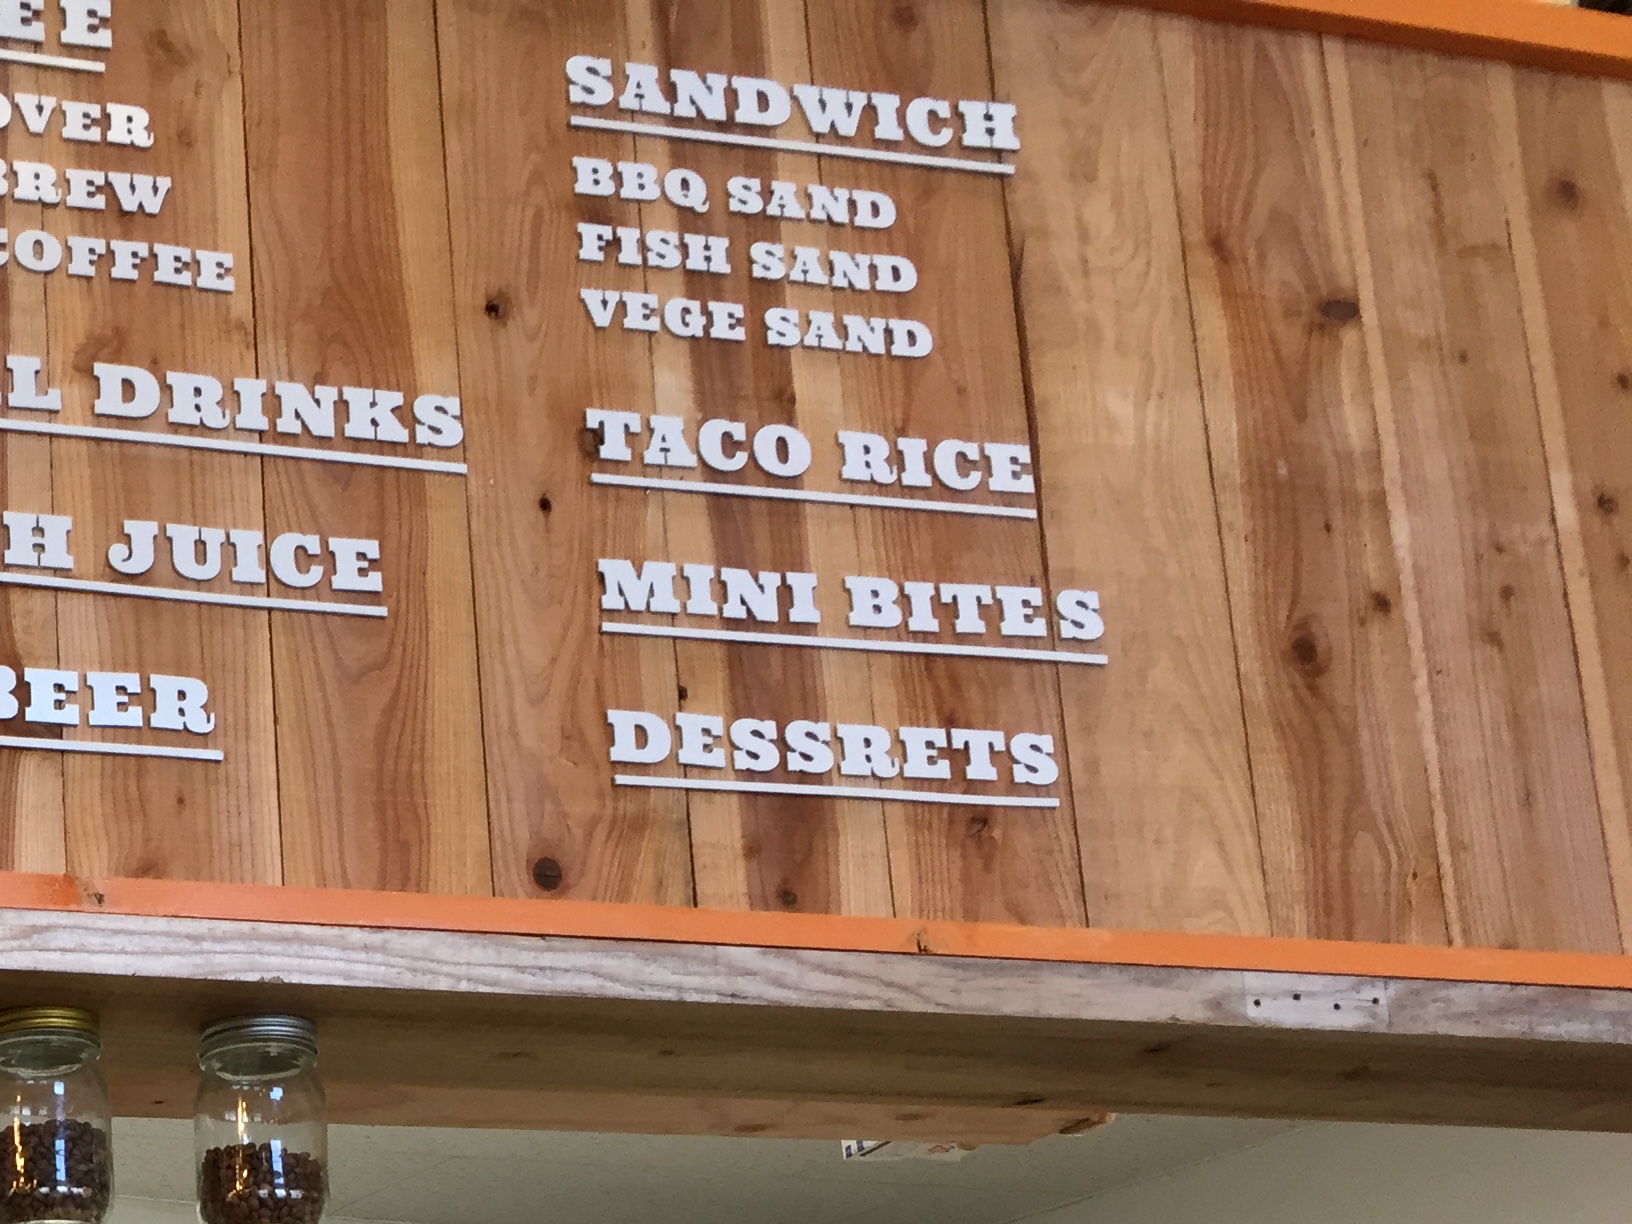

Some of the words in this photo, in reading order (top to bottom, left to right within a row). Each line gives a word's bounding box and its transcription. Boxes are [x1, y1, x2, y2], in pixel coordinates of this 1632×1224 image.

[567, 55, 1021, 151] SANDWICH
[572, 157, 710, 214] BBQ
[728, 177, 897, 229] SAND
[578, 222, 731, 274] FISH
[750, 242, 918, 294] SAND
[580, 288, 746, 341] VEGE
[765, 308, 933, 358] SAND
[93, 362, 465, 448] DRINKS
[585, 407, 812, 478] TACO
[838, 431, 1035, 494] RICE
[108, 520, 384, 592] JUICE
[598, 558, 821, 624] MINI
[844, 575, 1106, 641] BITES
[607, 709, 1060, 785] DESSRETS
